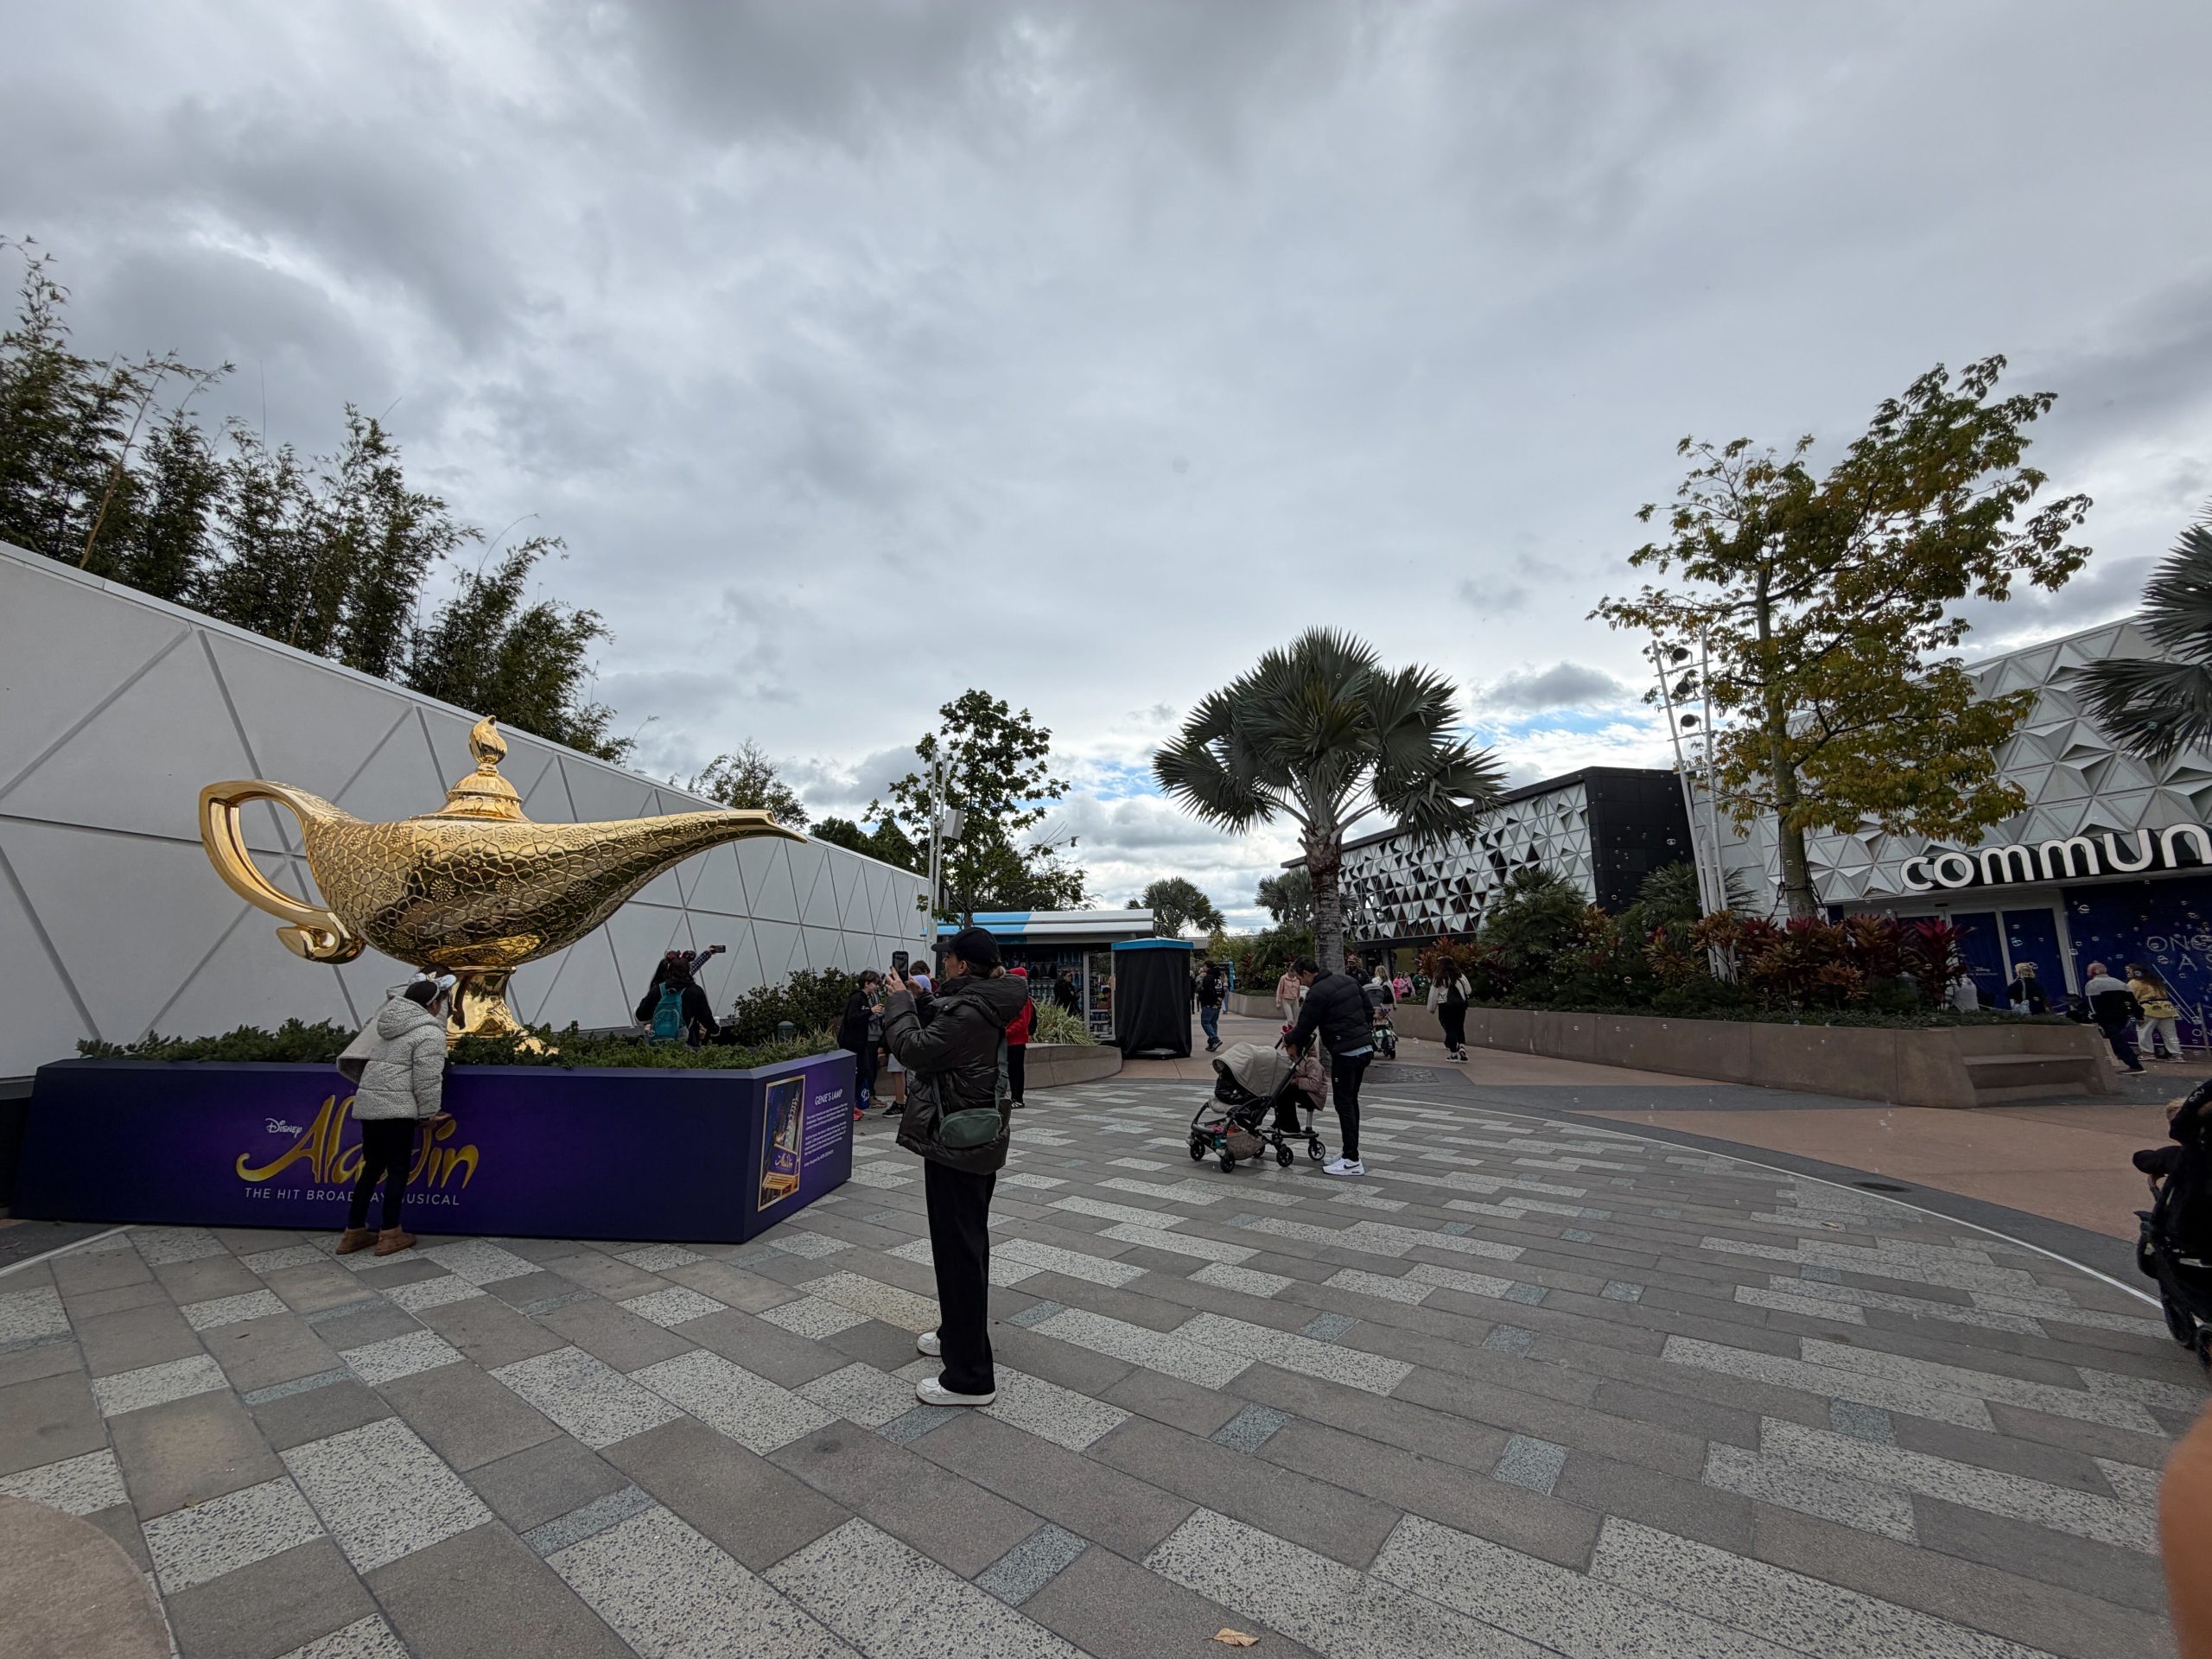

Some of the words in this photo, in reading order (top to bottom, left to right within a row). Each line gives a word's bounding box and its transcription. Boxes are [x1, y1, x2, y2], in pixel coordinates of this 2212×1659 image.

[814, 1091, 831, 1106] GENIE'S
[831, 1088, 843, 1101] LAMP
[265, 1117, 302, 1138] Disney
[235, 1094, 480, 1189] Aladin
[244, 1187, 271, 1199] THE
[276, 1188, 300, 1201] HIT
[402, 1192, 461, 1206] USICAL
